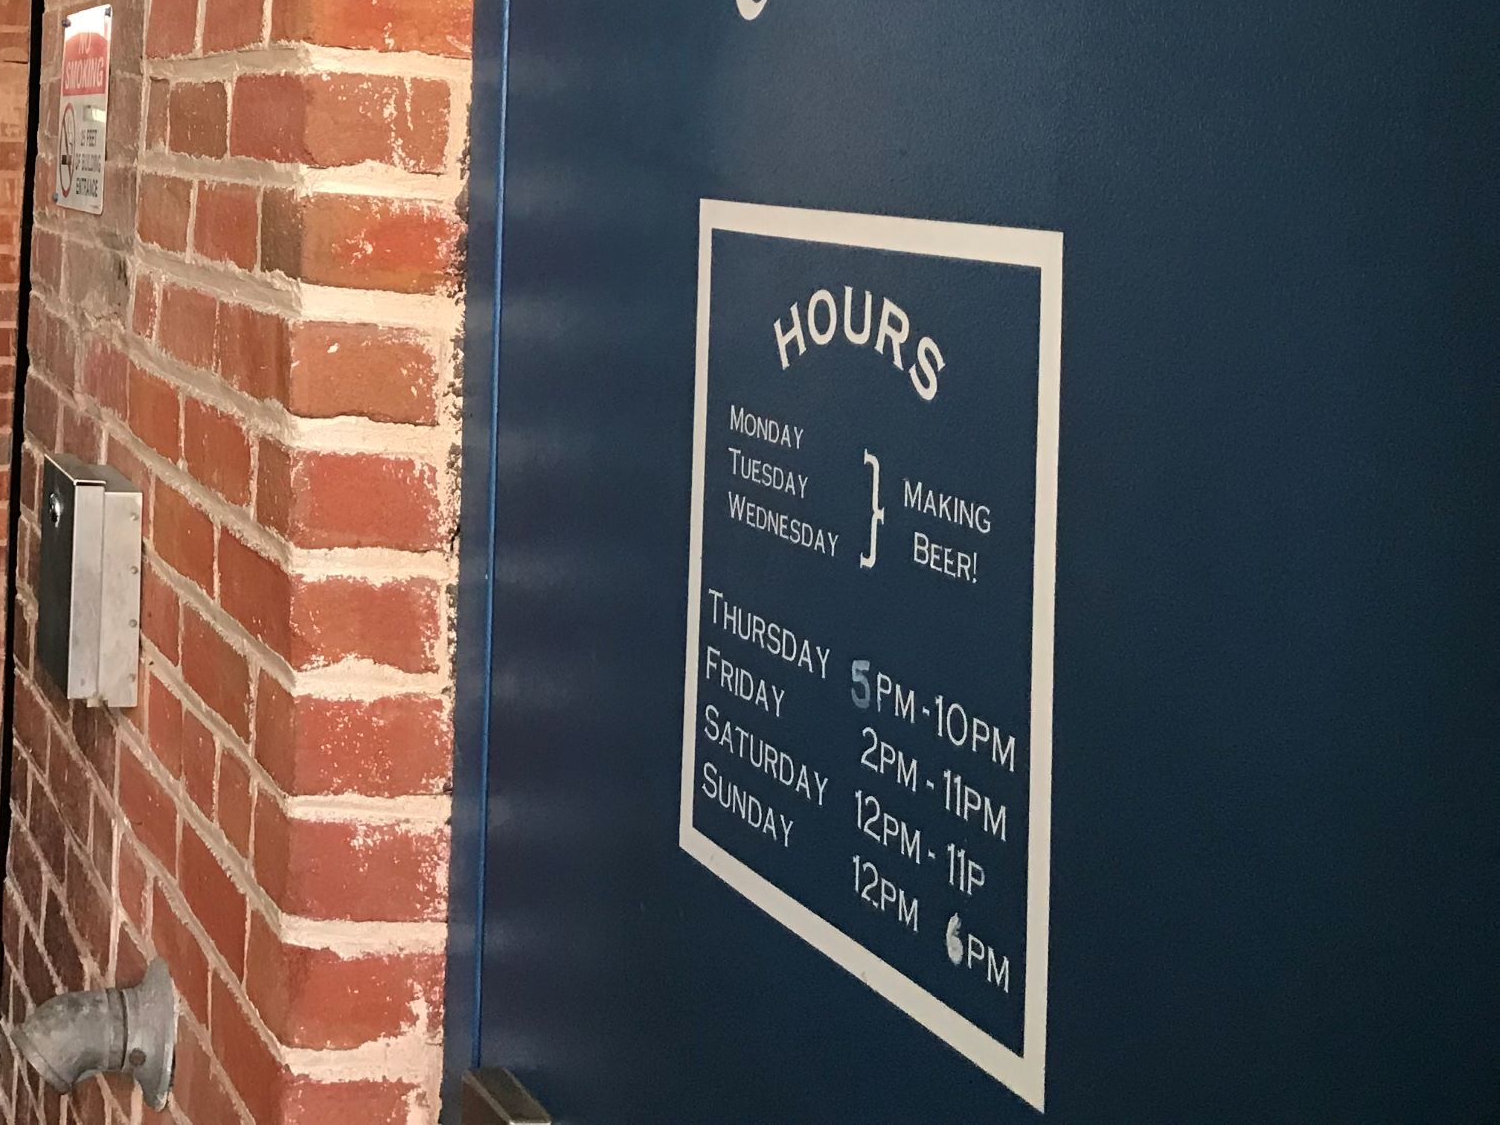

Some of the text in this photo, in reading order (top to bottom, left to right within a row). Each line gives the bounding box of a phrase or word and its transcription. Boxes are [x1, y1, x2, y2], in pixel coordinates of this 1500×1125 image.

[78, 32, 93, 55] NO
[65, 57, 104, 91] SMOKING
[75, 177, 98, 198] ENTRANCE
[773, 286, 946, 401] HOURS
[852, 854, 918, 932] 12PM
